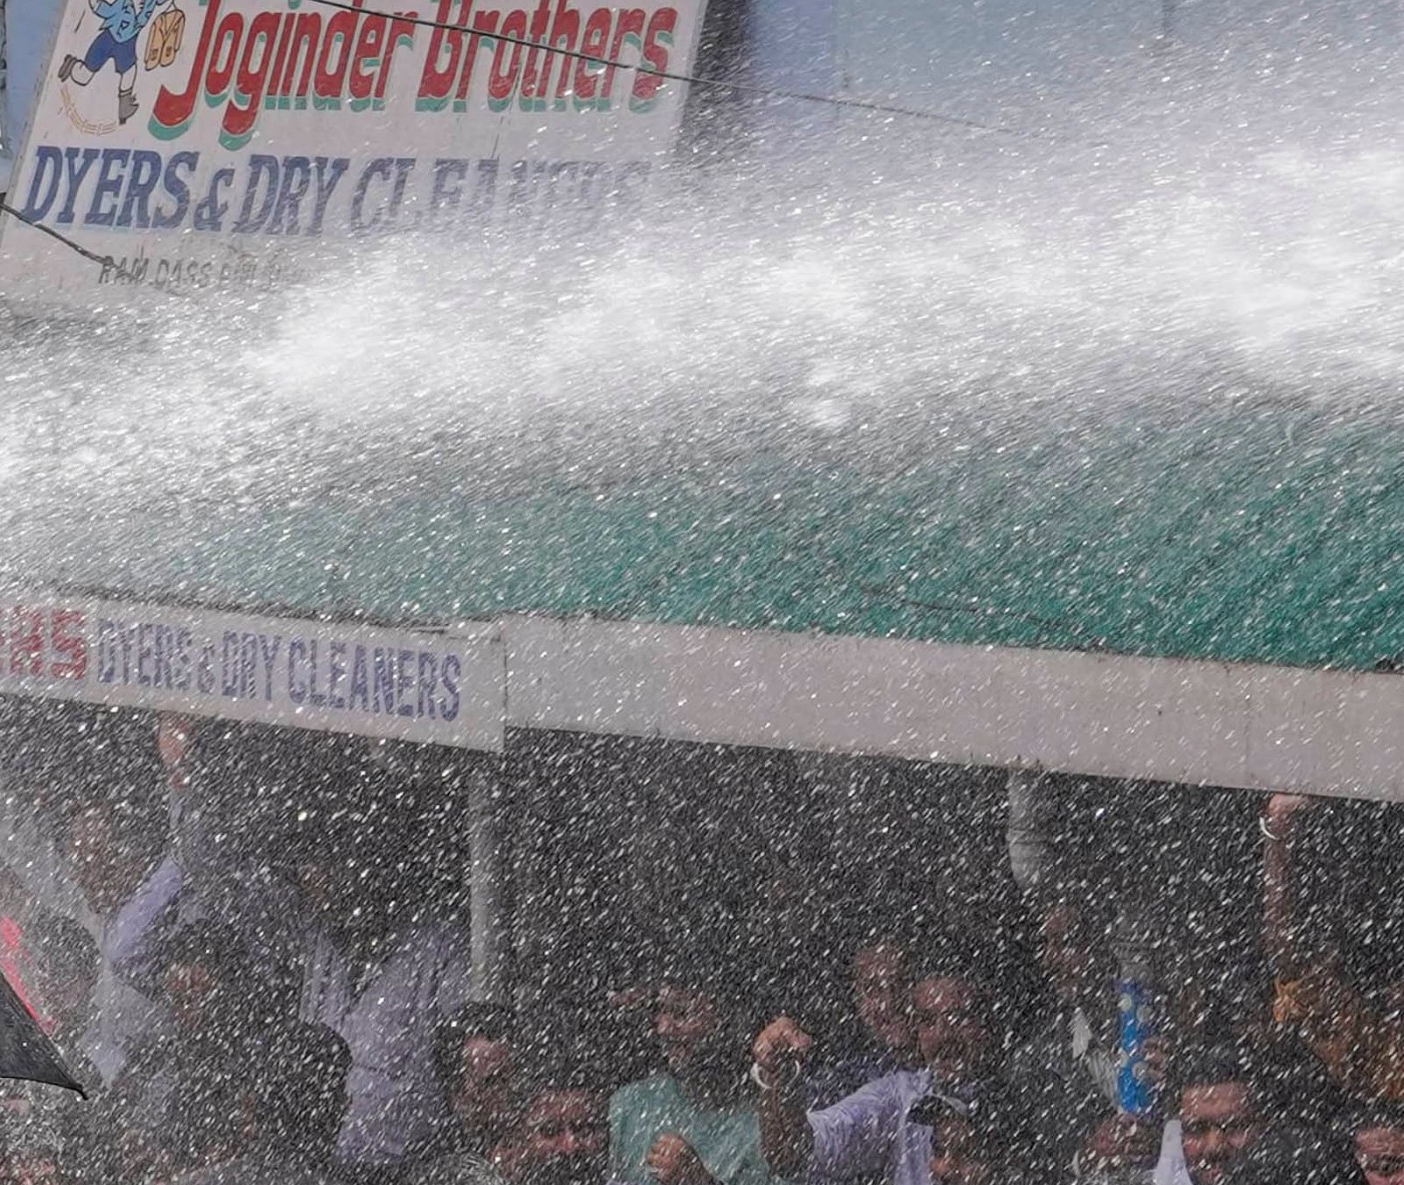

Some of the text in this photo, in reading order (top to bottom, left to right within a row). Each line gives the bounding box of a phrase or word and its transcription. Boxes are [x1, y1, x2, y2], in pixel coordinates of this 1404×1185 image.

[148, 0, 679, 150] Joginder Brothers
[22, 145, 199, 230] DYERS
[194, 168, 234, 233] &
[232, 154, 352, 236] DRY
[97, 618, 190, 691] DYERS
[222, 629, 282, 701] DRY
[289, 635, 462, 722] CLEANERS
